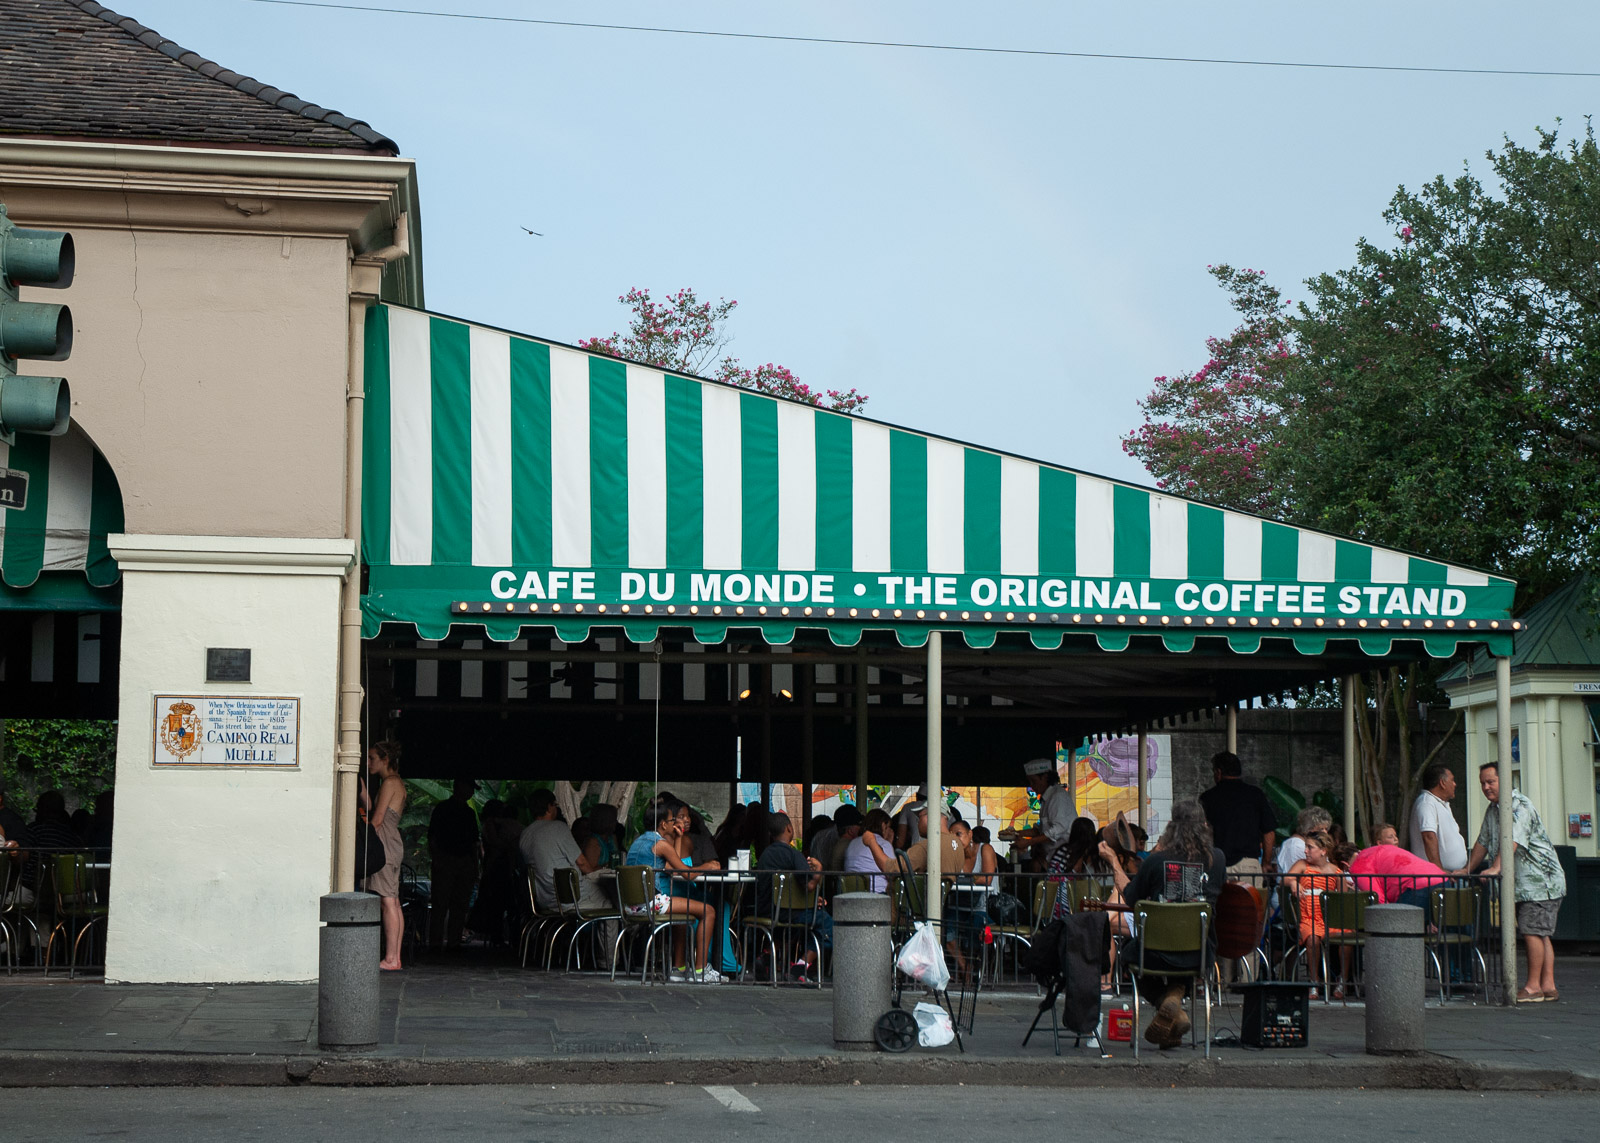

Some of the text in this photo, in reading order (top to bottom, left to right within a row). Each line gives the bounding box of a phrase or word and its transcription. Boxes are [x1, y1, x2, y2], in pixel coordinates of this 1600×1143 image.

[490, 570, 1467, 617] CAFE DU MONDE THE ORIGINAL COFFEE STAND
[208, 701, 222, 709] When
[224, 701, 234, 709] New
[236, 701, 255, 709] Orleans
[260, 731, 294, 744] REAL
[225, 747, 277, 761] MUELLE
